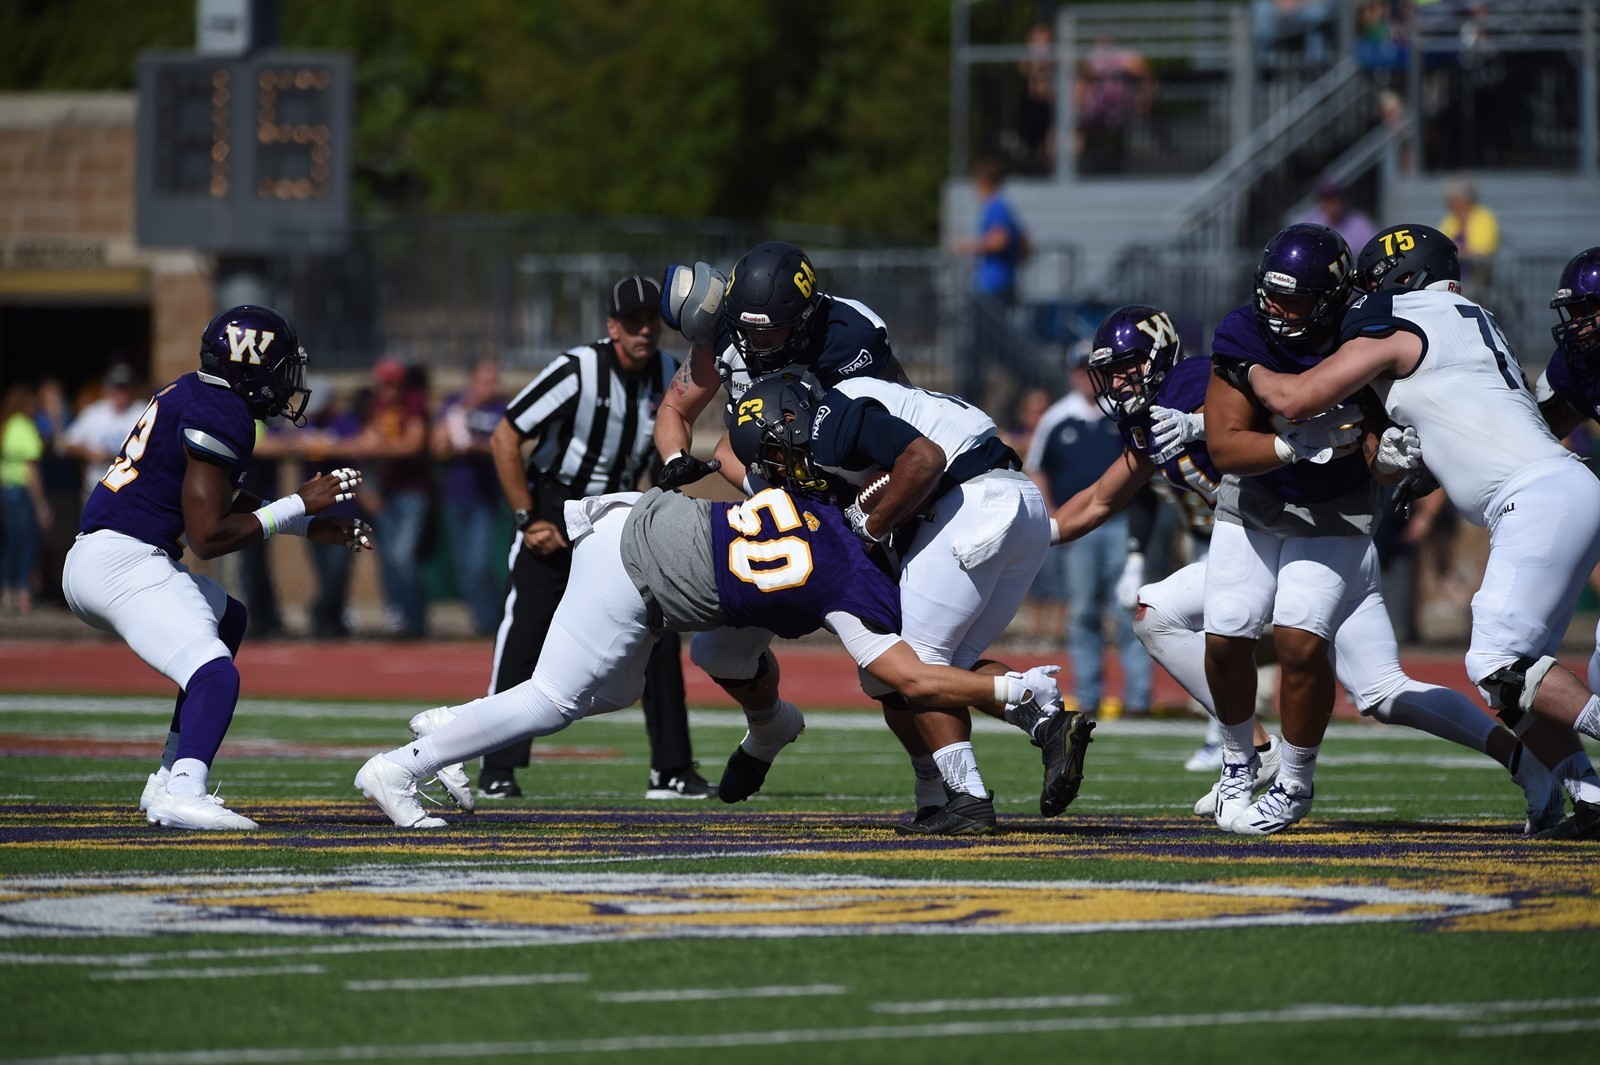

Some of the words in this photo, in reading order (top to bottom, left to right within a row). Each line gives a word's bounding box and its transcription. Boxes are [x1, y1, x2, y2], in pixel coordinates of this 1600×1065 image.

[210, 68, 331, 199] 15
[1378, 229, 1416, 257] 75
[793, 260, 817, 299] 64
[225, 325, 275, 366] W
[1135, 311, 1178, 349] W
[844, 354, 870, 375] NAU
[737, 398, 764, 426] 13
[812, 408, 827, 437] NAU
[101, 395, 159, 493] 2
[726, 486, 814, 593] 50
